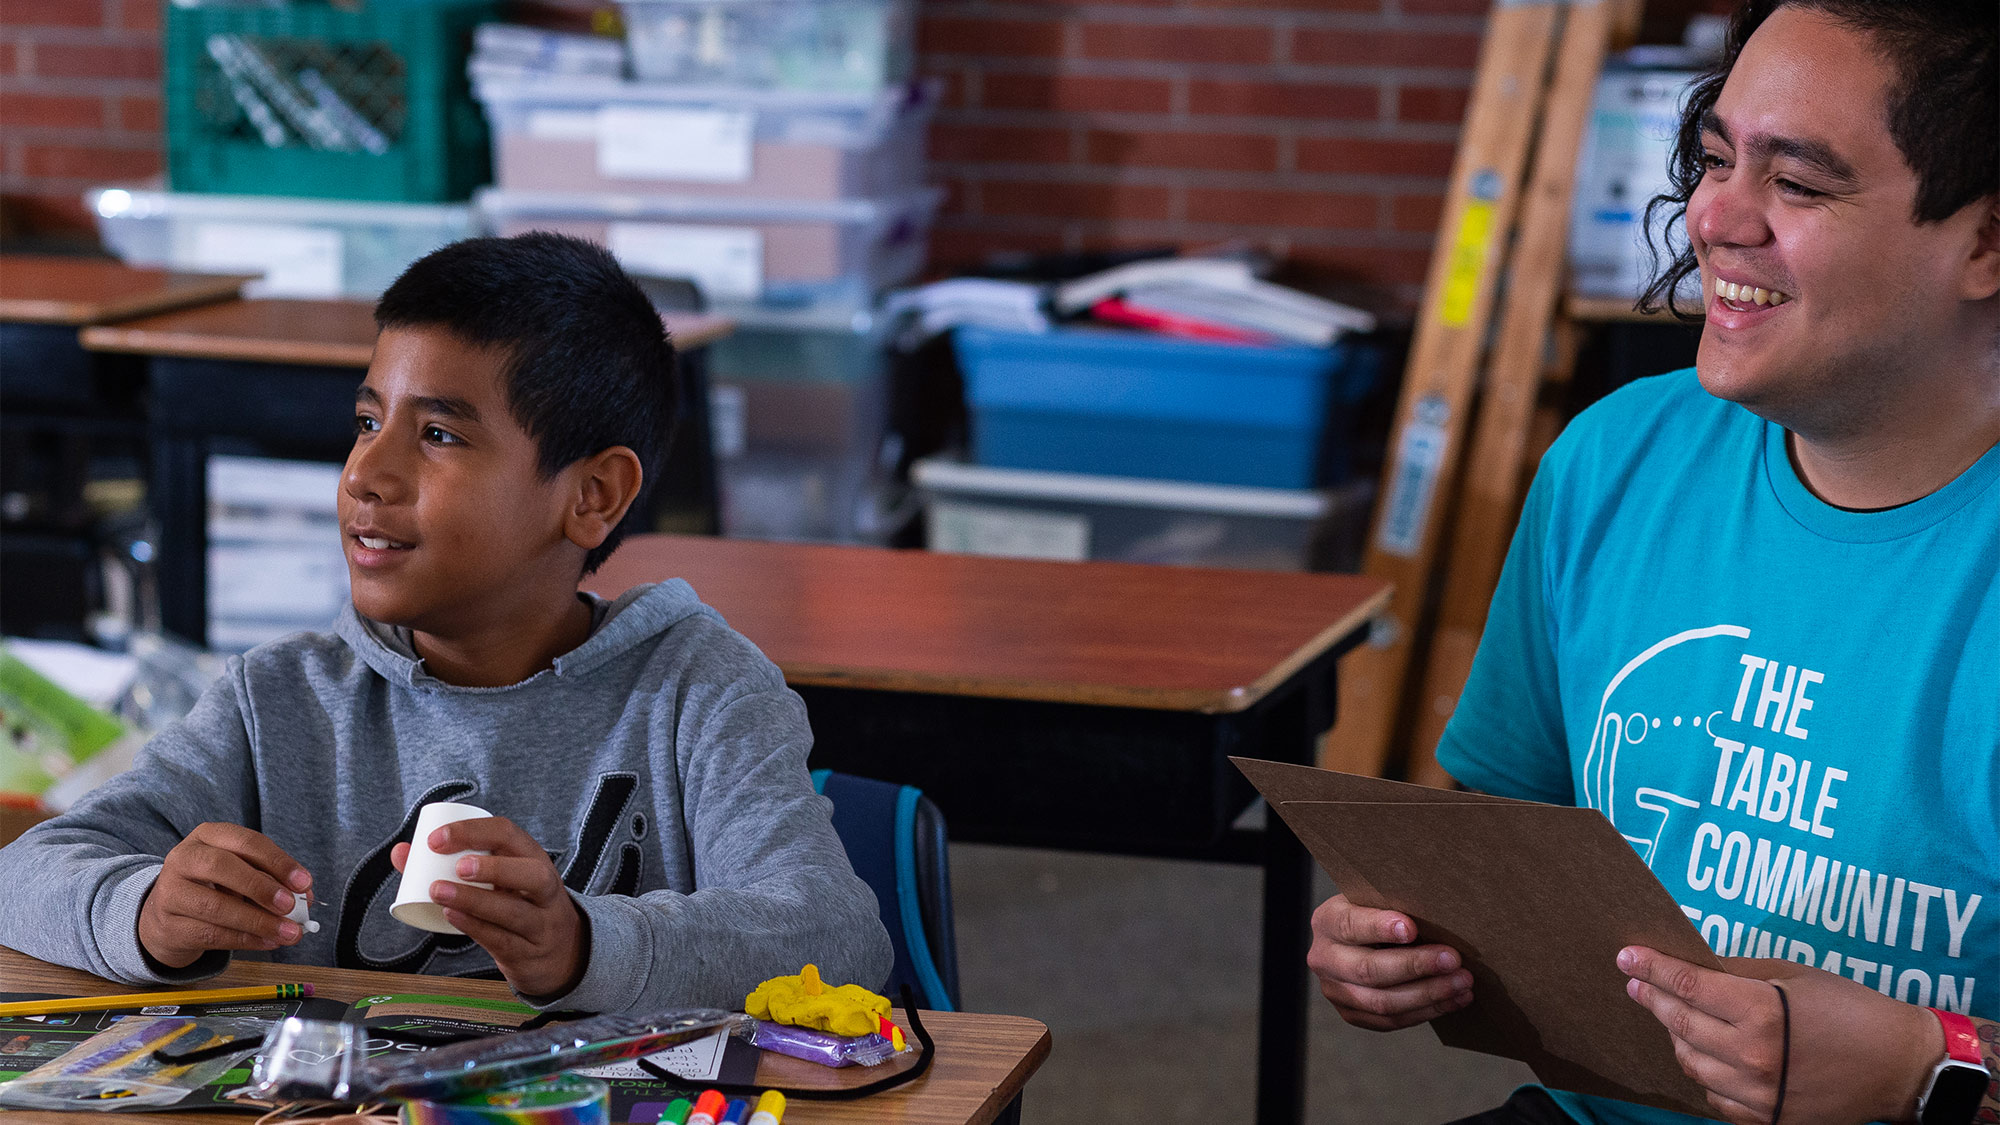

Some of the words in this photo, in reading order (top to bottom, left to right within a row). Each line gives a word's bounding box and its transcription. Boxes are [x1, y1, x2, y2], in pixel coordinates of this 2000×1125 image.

[1731, 653, 1825, 740] THE
[1711, 736, 1849, 839] TABLE
[1686, 822, 1983, 958] COMMUNITY
